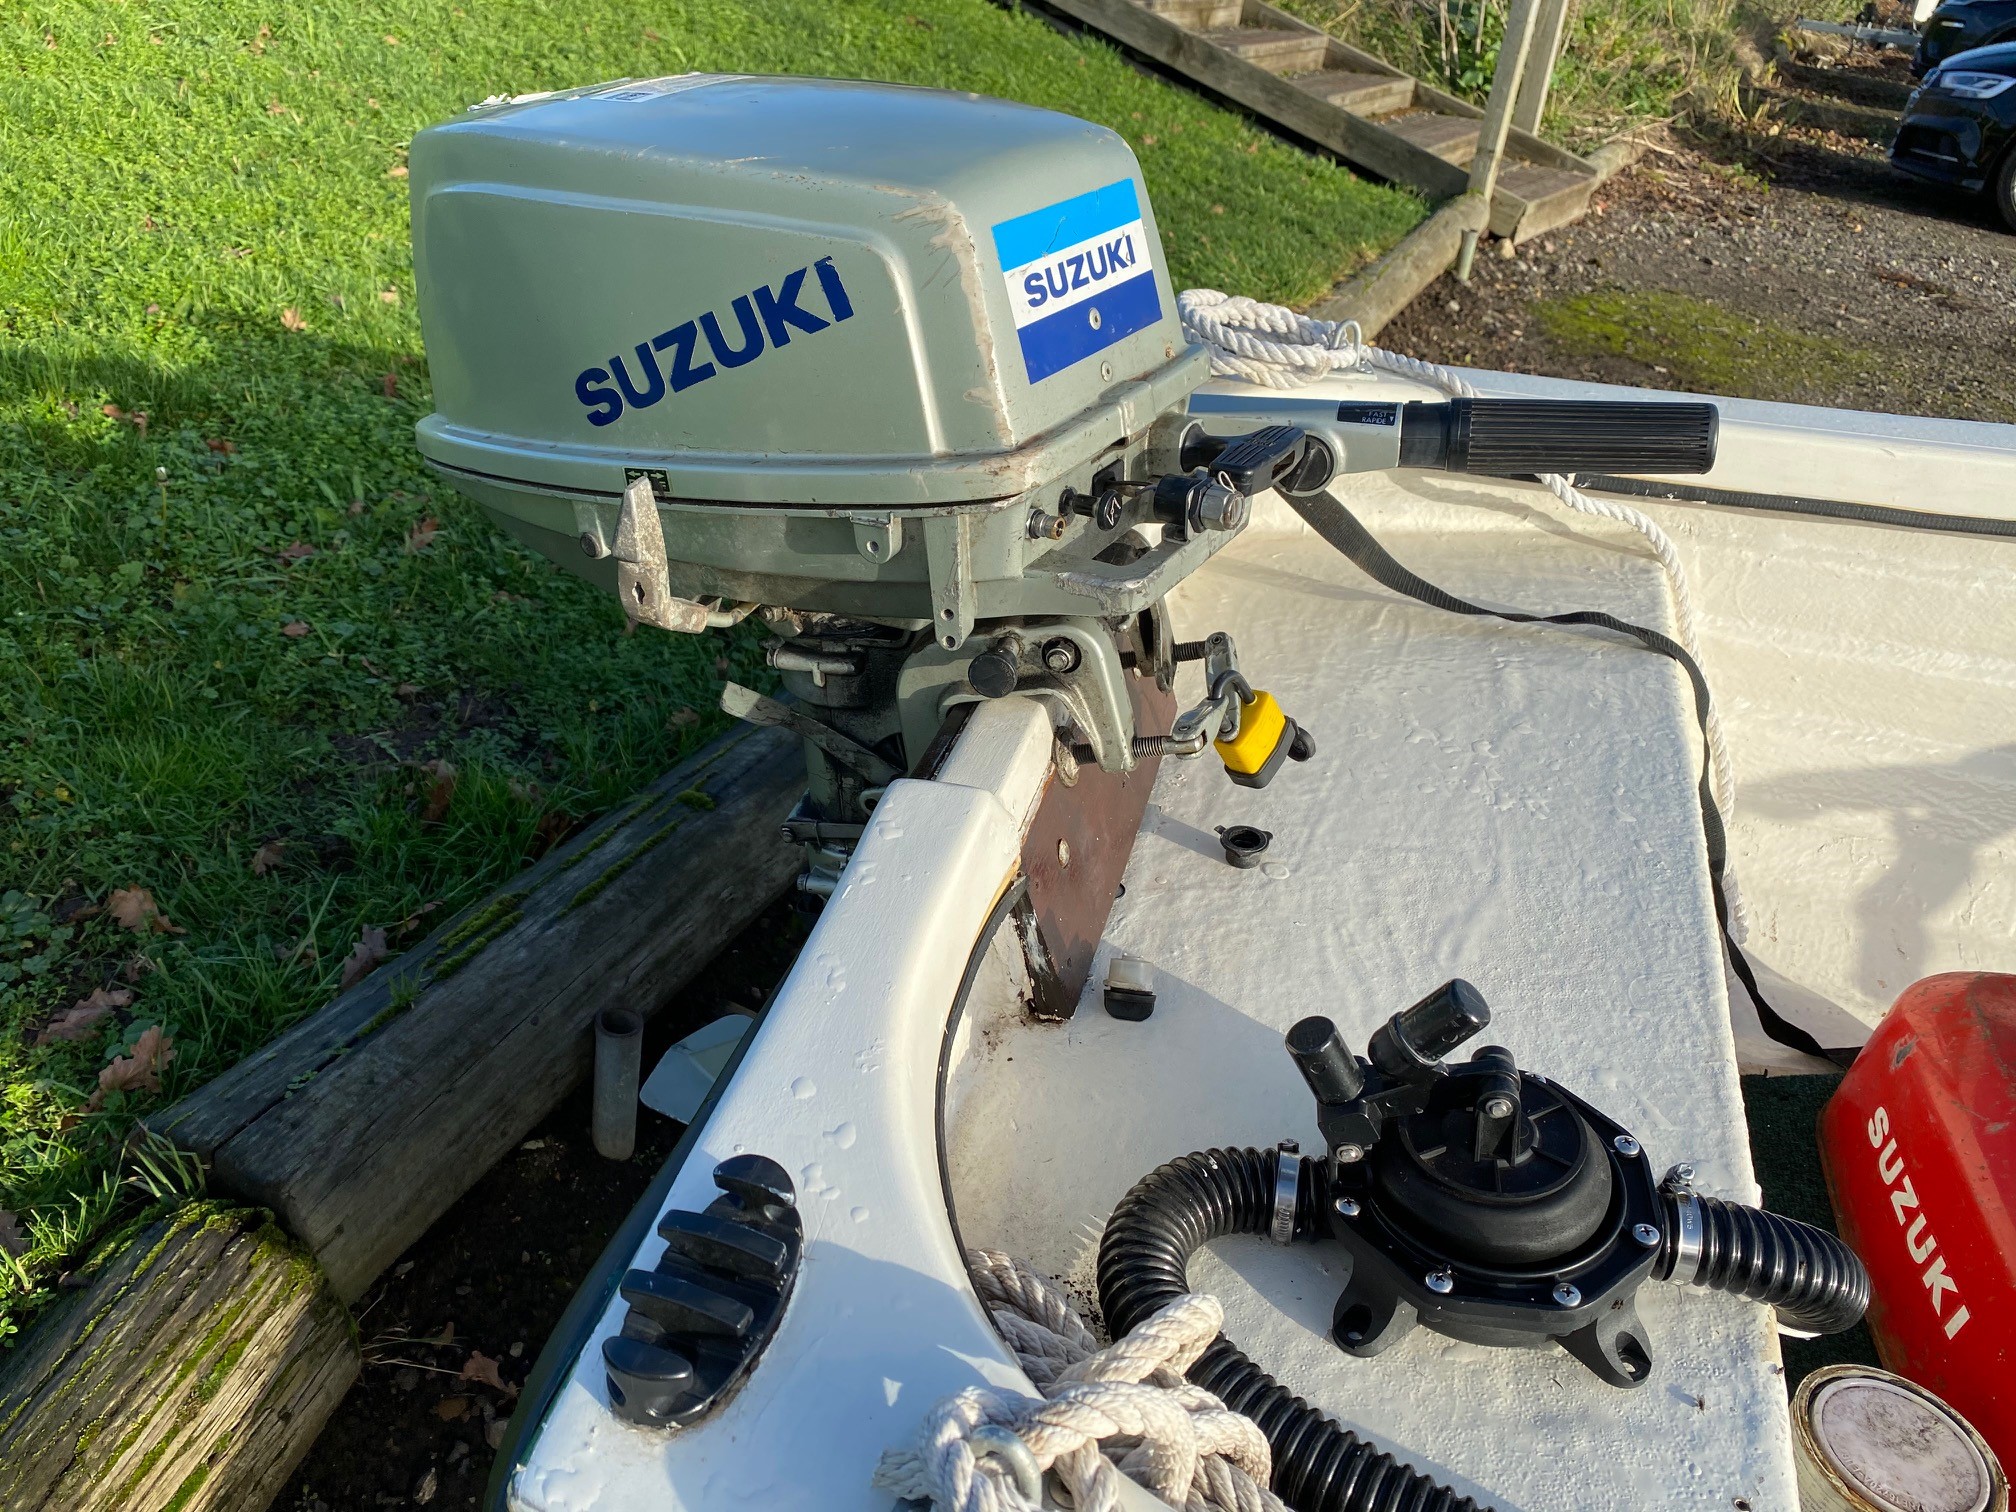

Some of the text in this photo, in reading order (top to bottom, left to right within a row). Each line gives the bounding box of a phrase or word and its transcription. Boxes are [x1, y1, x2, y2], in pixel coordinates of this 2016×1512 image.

[1024, 234, 1136, 308] SUZUKI
[575, 255, 854, 427] SUZUKI
[1361, 416, 1387, 425] RAPIDE
[1868, 1106, 1970, 1340] SUZUKI
